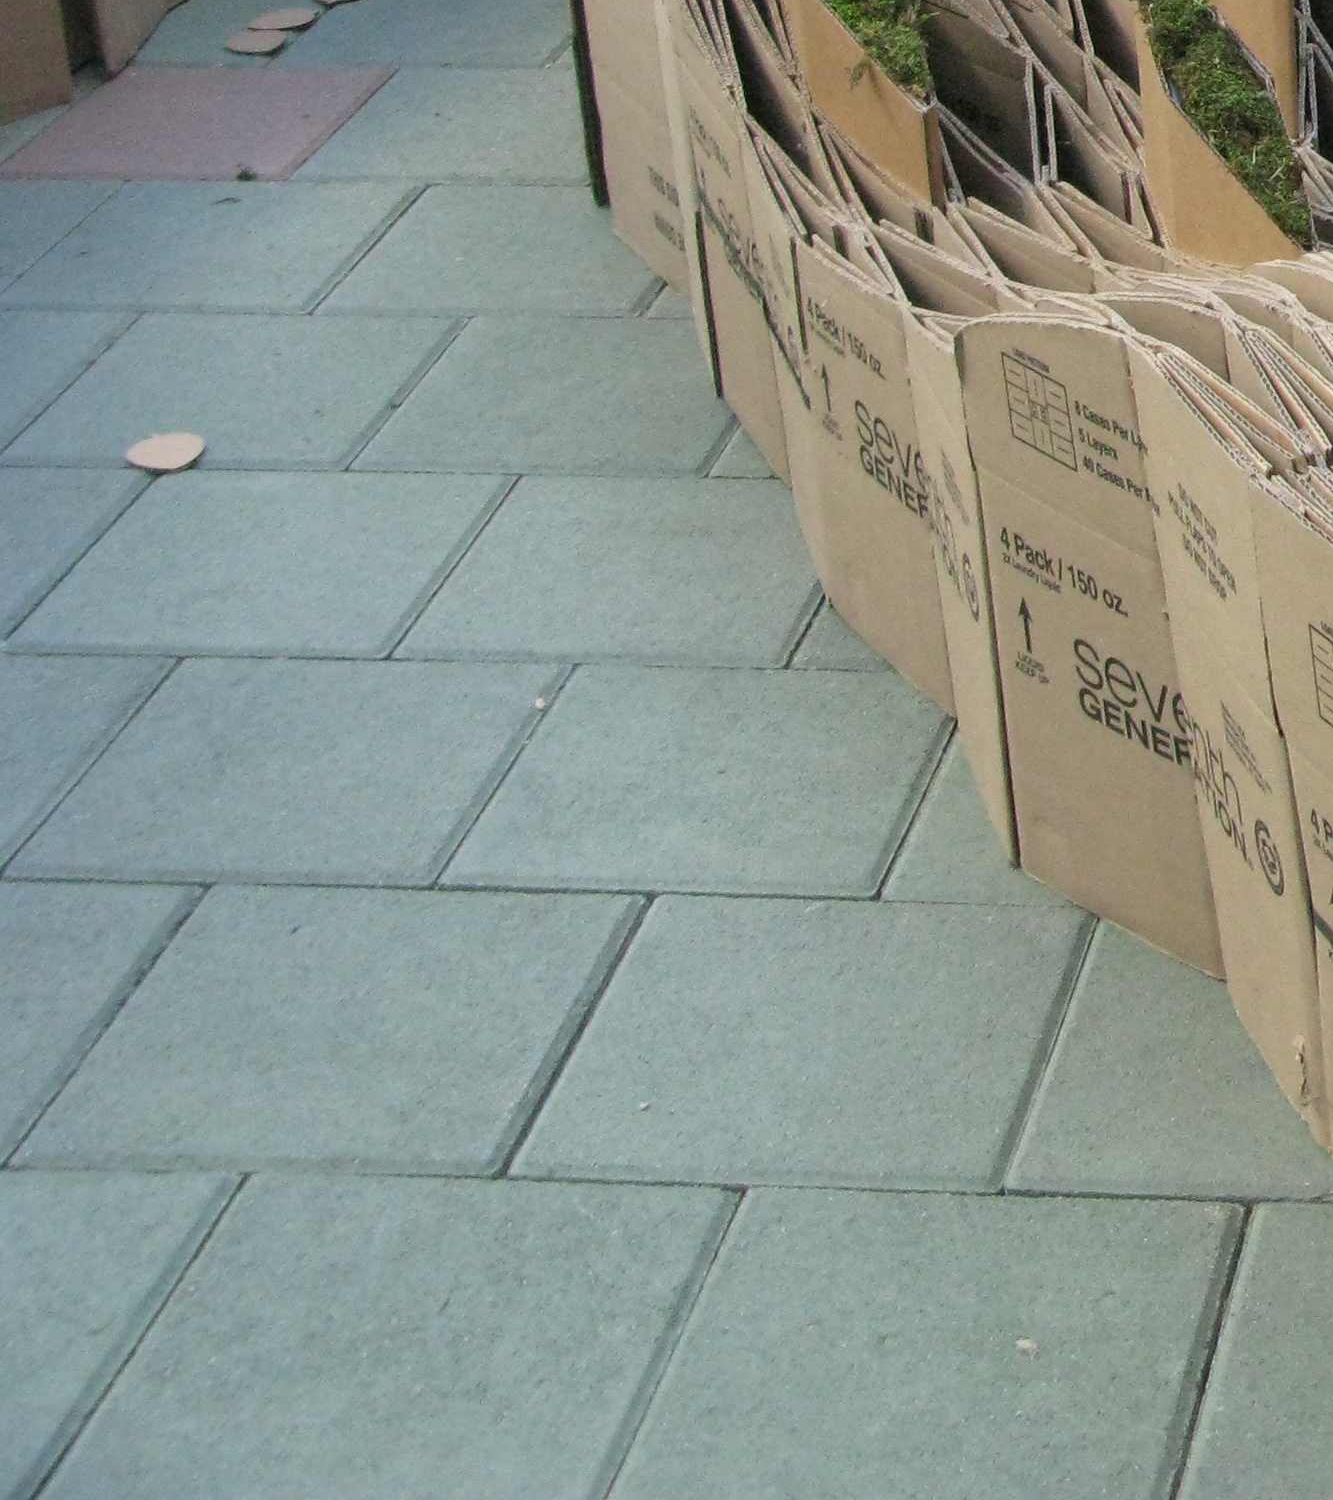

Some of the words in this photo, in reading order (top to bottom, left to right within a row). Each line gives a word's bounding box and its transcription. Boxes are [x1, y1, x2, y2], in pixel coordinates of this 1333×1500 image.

[1001, 527, 1010, 551] 4
[1013, 532, 1055, 577] Pack
[1058, 557, 1063, 581] /
[1066, 565, 1098, 601] 150
[1102, 588, 1129, 618] oz.
[1310, 808, 1320, 836] 4
